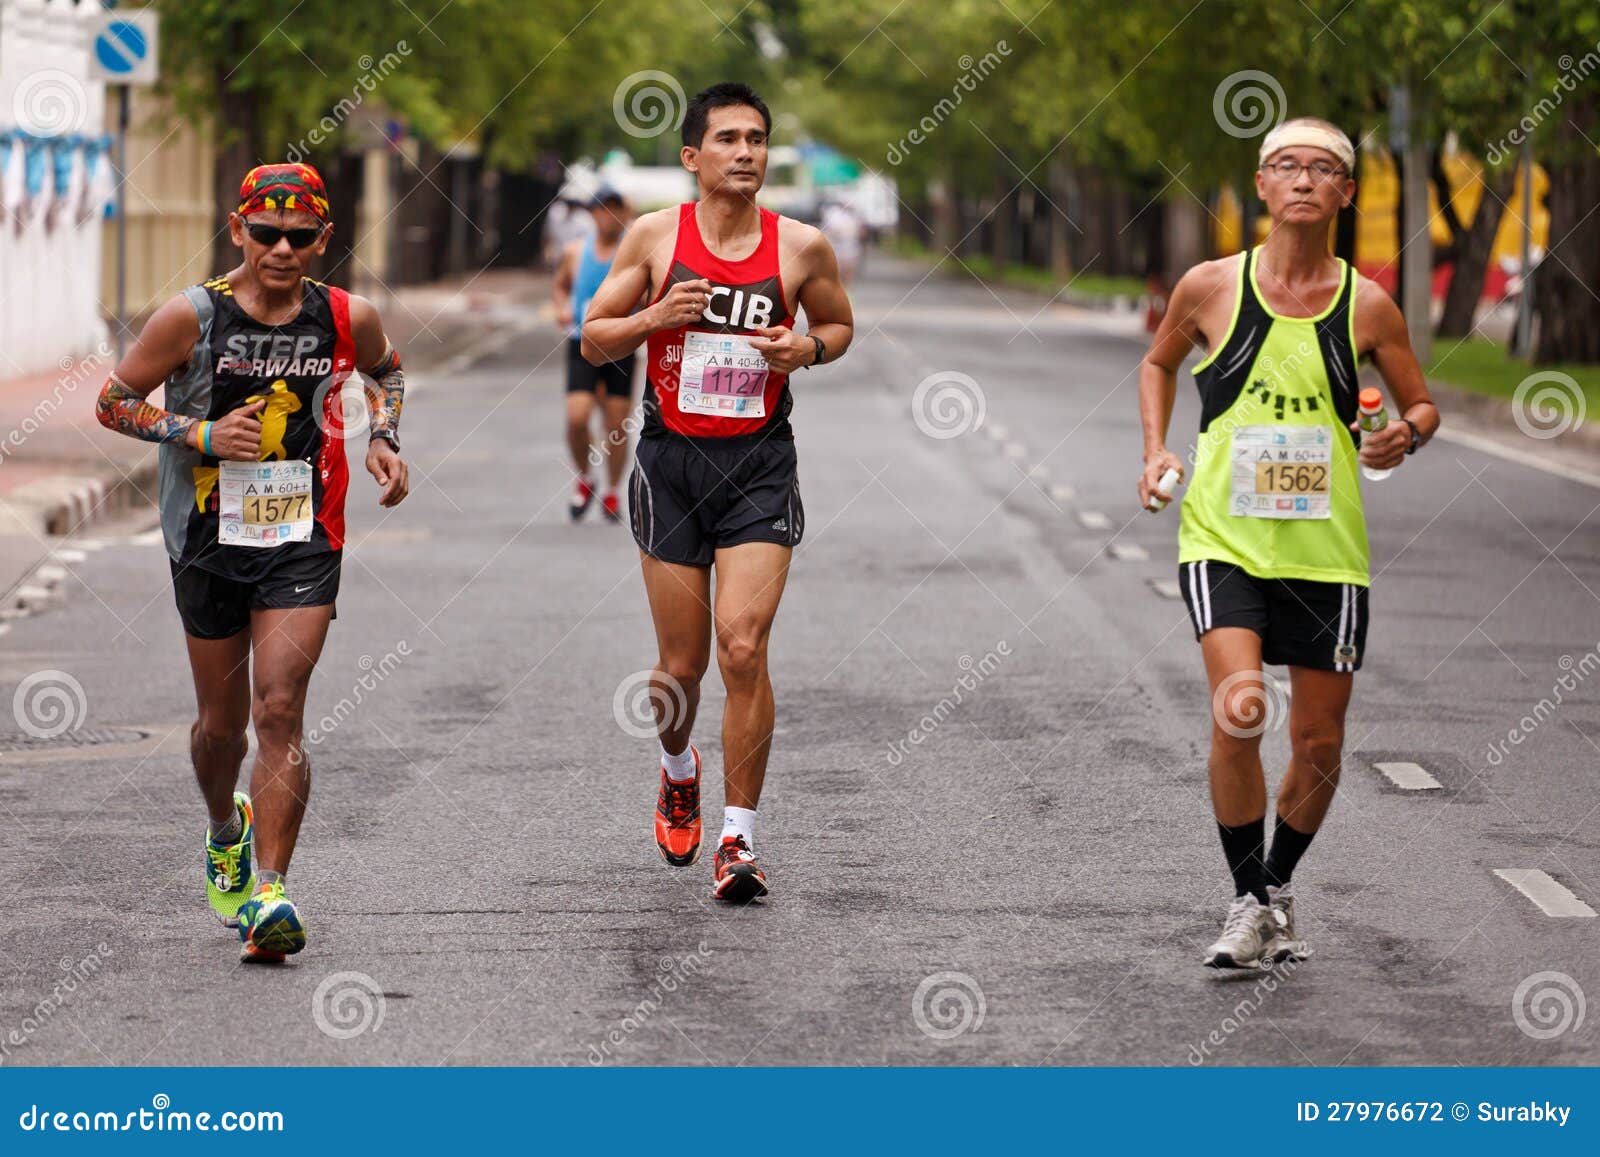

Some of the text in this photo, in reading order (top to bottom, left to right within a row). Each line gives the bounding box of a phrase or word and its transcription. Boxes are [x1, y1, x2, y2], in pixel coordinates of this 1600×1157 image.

[703, 286, 773, 330] CIB
[225, 334, 319, 359] STEP
[706, 355, 766, 368] A M 40-49
[711, 370, 764, 394] 1127
[1259, 450, 1272, 460] A
[1279, 451, 1288, 460] M
[245, 482, 308, 495] A M 60++
[1265, 466, 1326, 491] 1562
[251, 495, 307, 522] 1577
